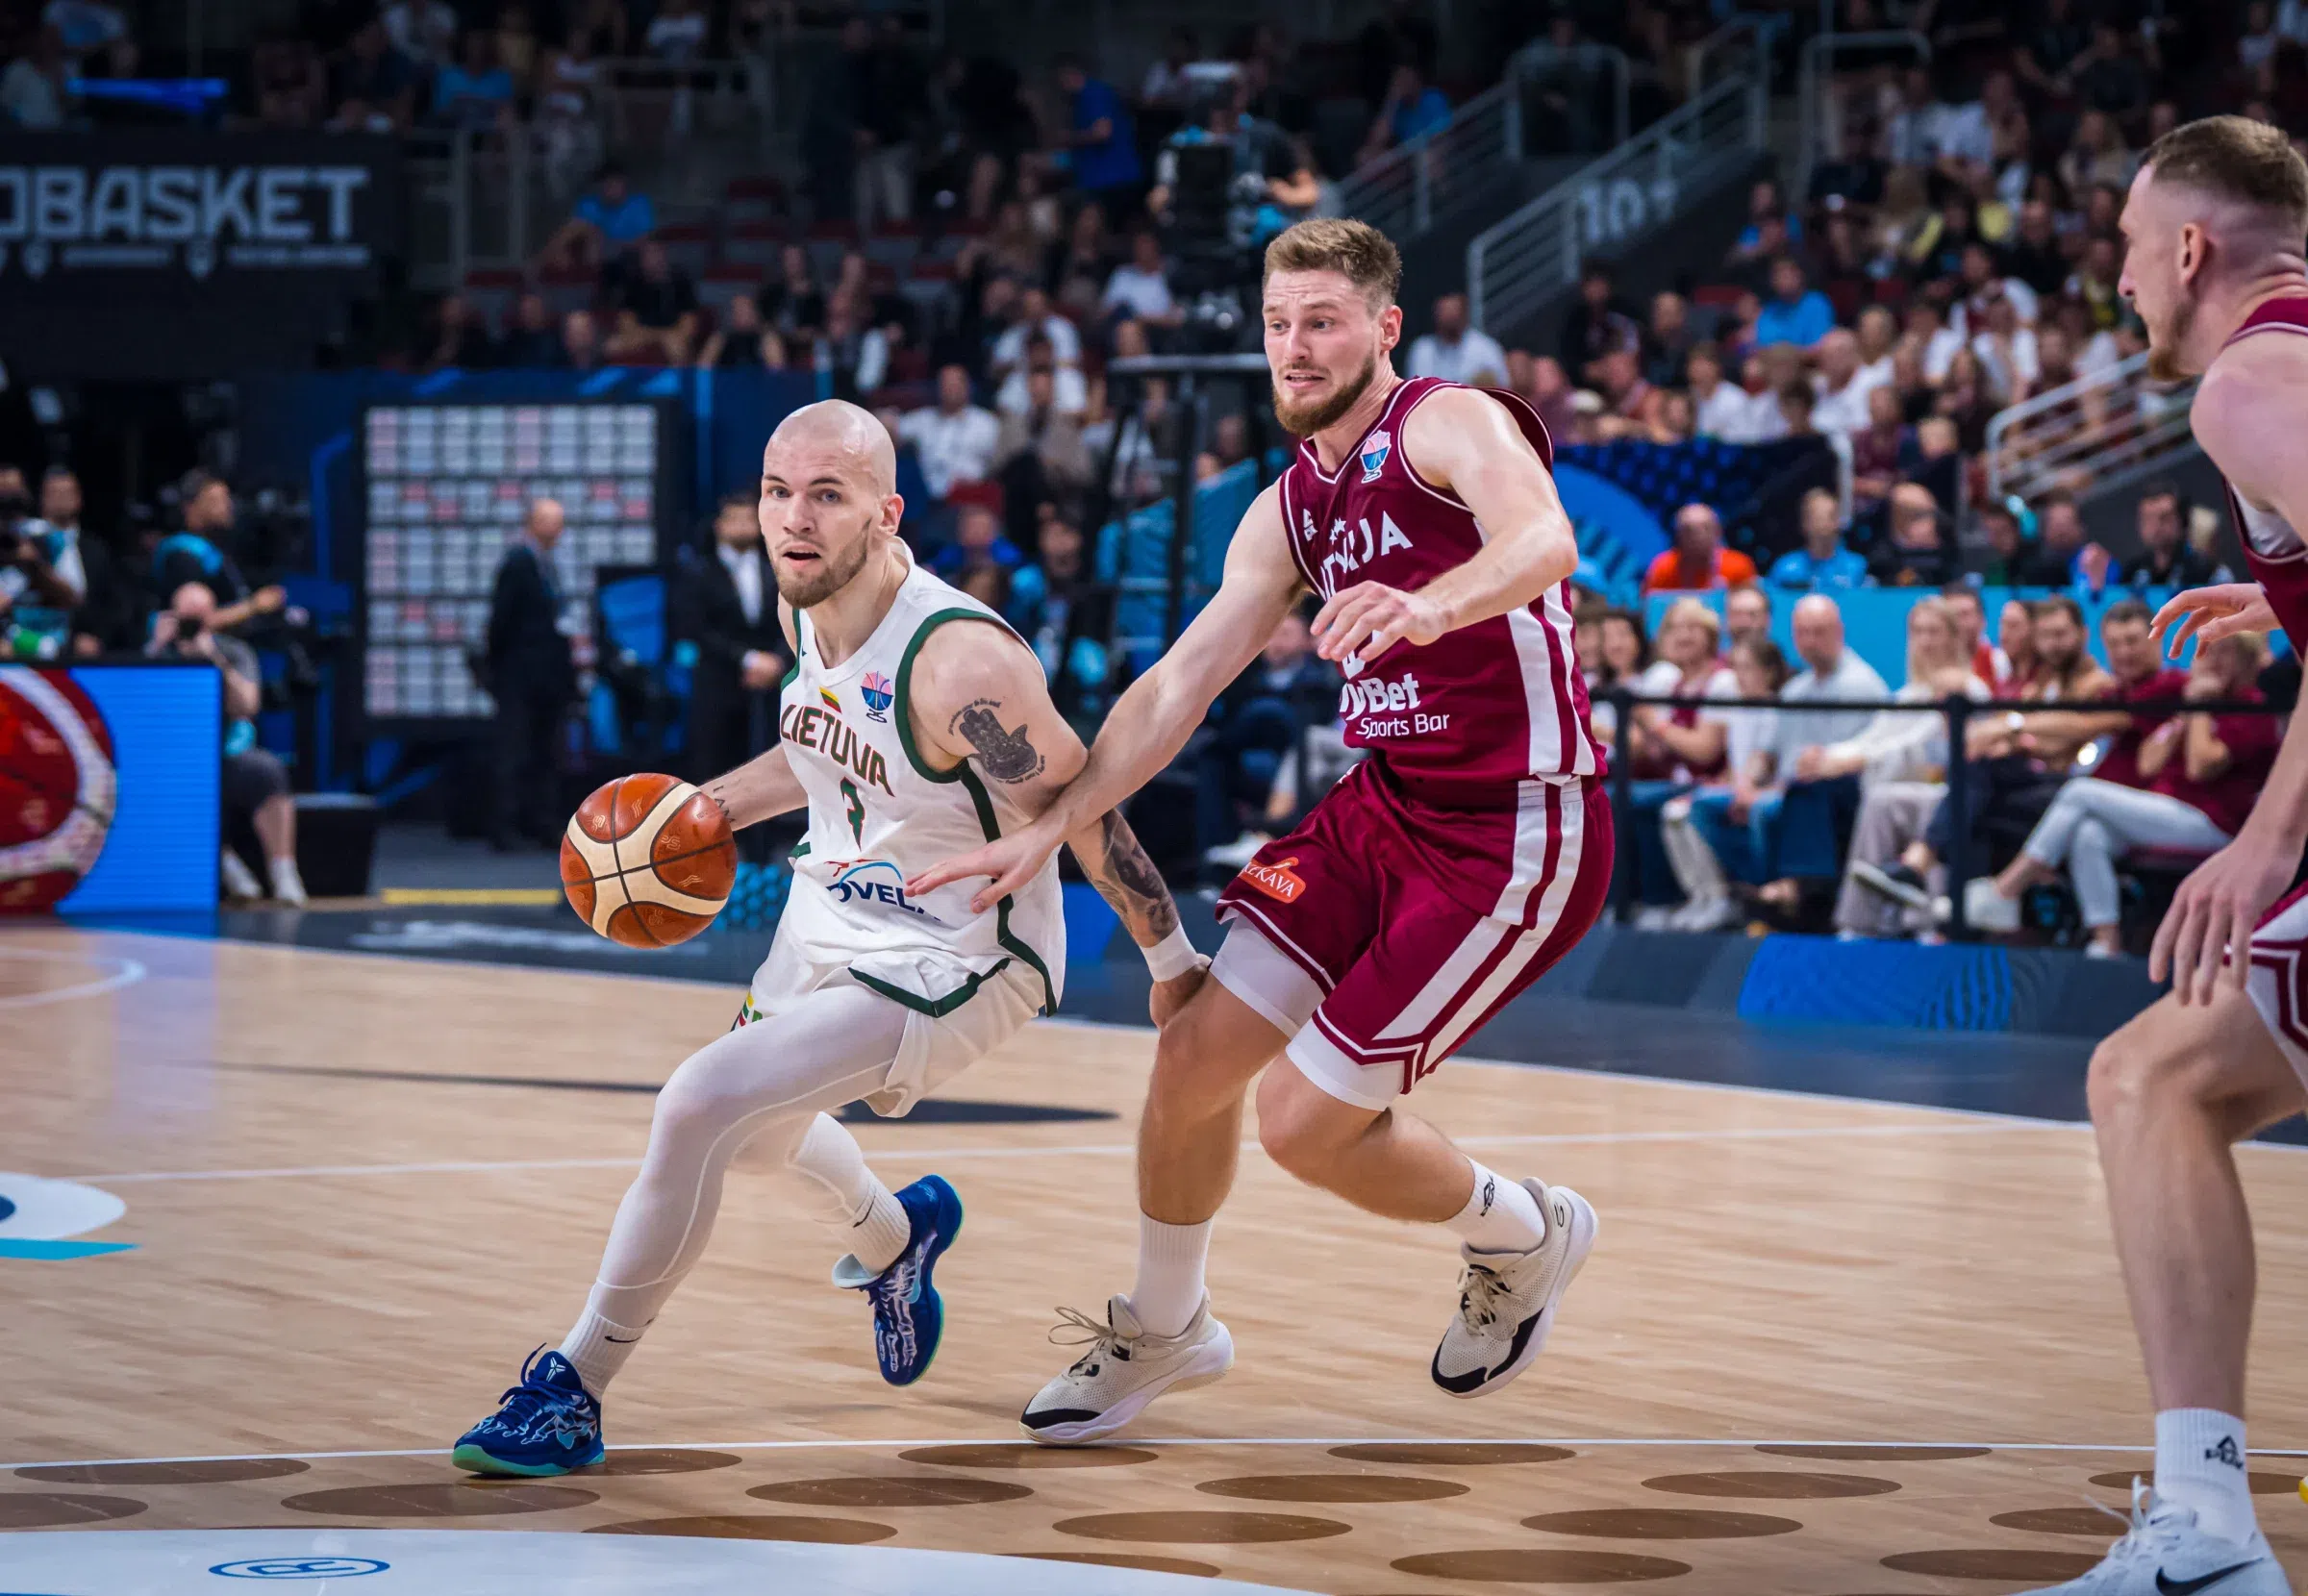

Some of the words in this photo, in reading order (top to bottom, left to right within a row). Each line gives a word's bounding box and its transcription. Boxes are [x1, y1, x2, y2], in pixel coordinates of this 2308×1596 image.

[1340, 673, 1421, 721] lyBet
[1356, 717, 1410, 739] Sports
[1414, 713, 1450, 735] Bar
[781, 704, 896, 798] LIETUVA
[825, 880, 941, 922] OVEL
